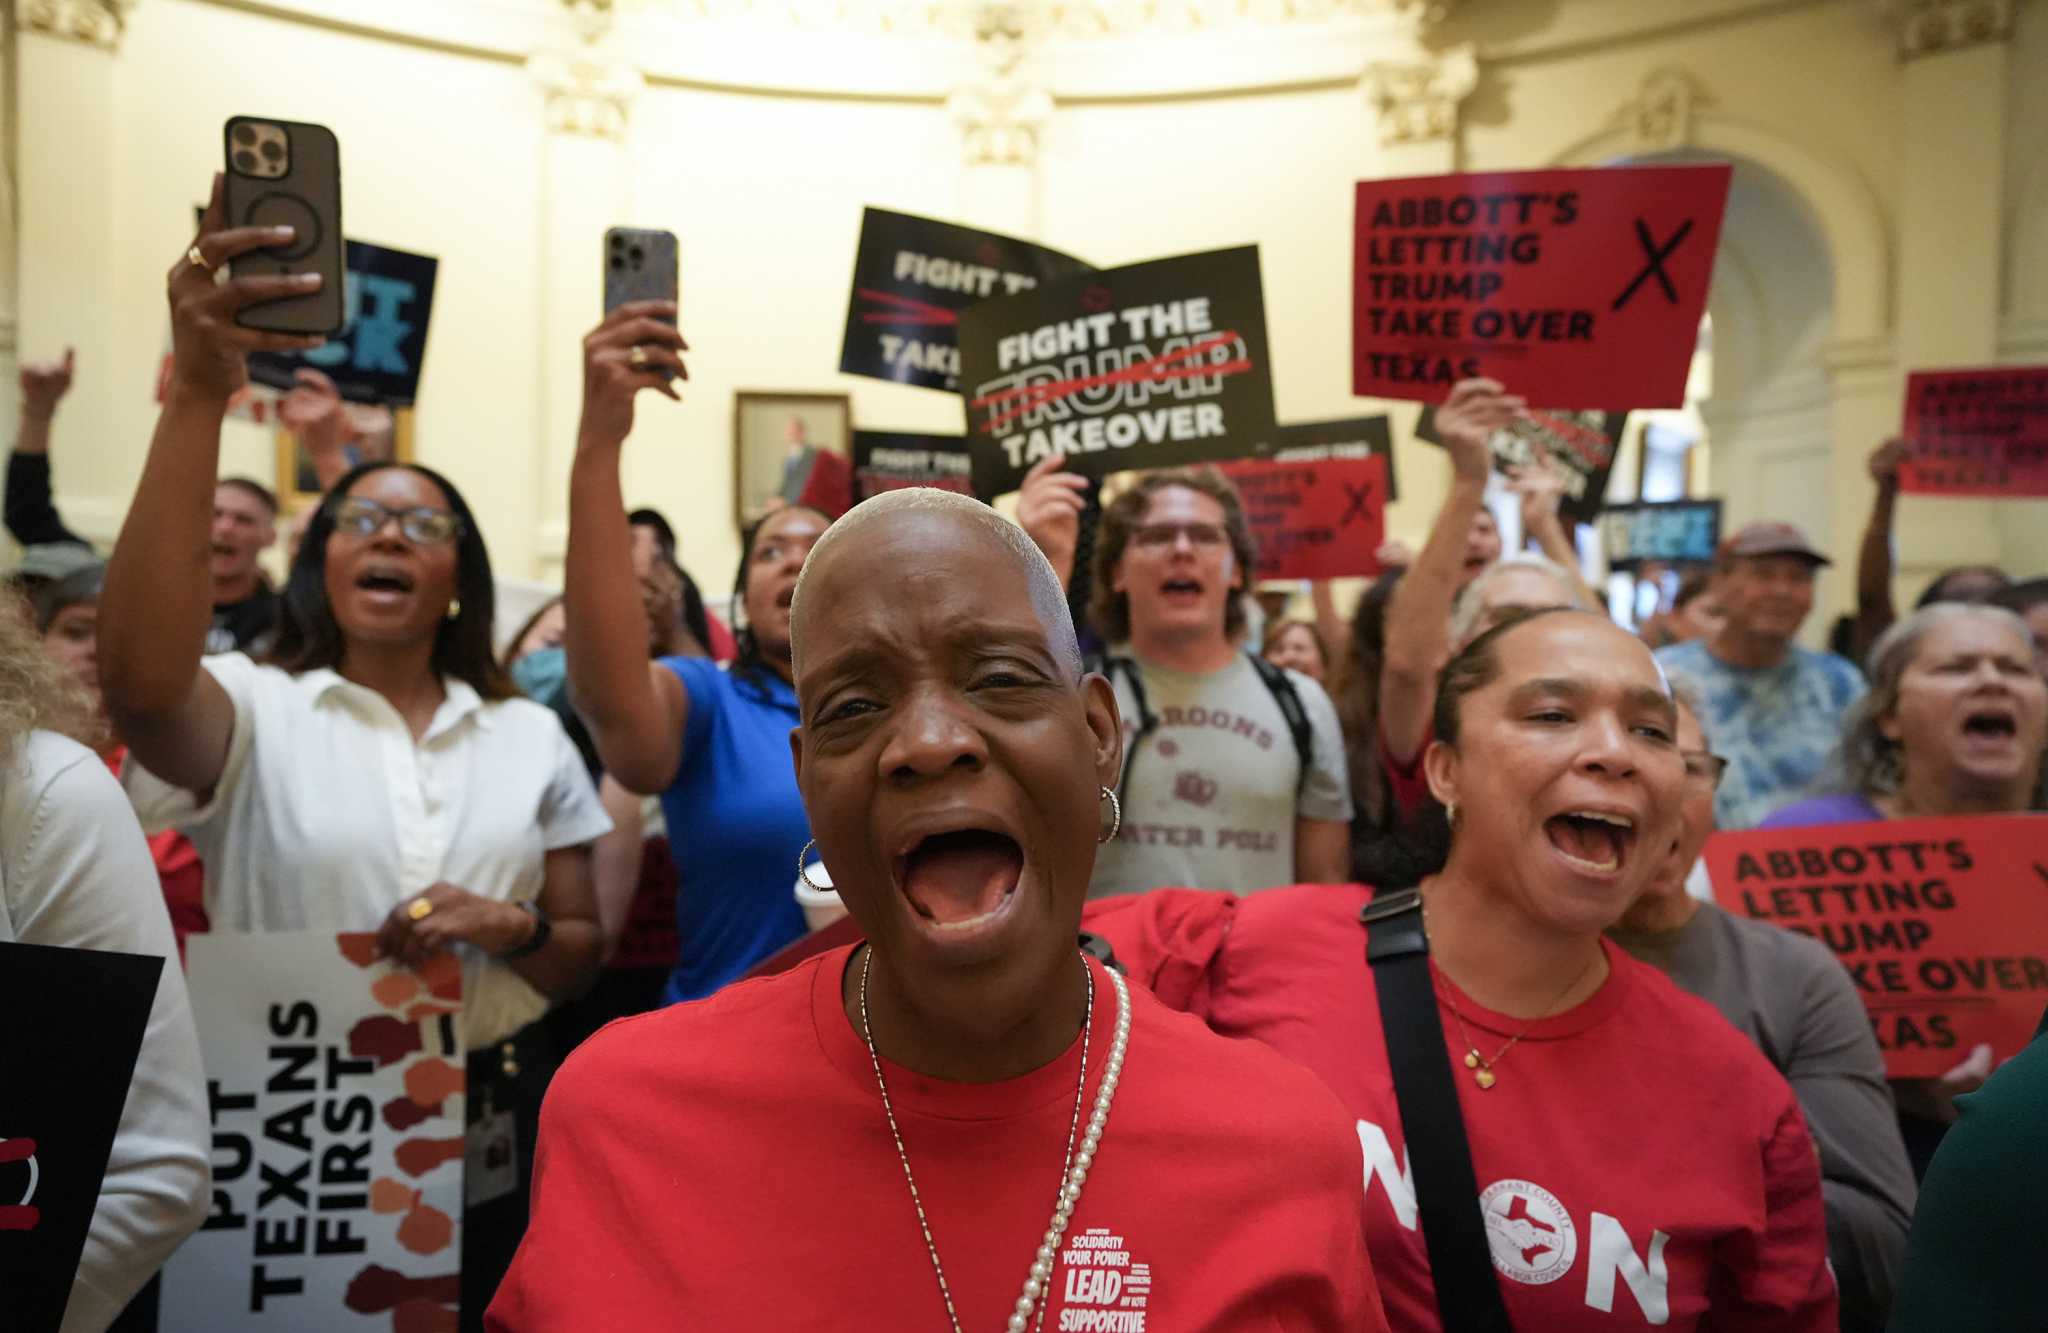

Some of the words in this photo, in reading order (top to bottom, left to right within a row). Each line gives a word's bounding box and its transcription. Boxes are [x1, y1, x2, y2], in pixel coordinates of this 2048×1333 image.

[1371, 190, 1579, 230] ABBOTT'S
[1368, 232, 1541, 266] LETTING
[893, 249, 999, 297] FIGHT
[1367, 271, 1504, 303] TRUMP
[997, 311, 1117, 371] FIGHT
[1121, 297, 1213, 342] THE
[1367, 307, 1462, 338] TAKE
[1471, 307, 1595, 341] OVER
[974, 330, 1248, 438] TRUMP
[1367, 352, 1480, 384] TEXAS
[999, 402, 1226, 468] TAKEOVER
[1162, 704, 1274, 751] ROONS
[1118, 823, 1204, 847] ATER
[1735, 839, 1974, 883] ABBOTT'S
[1741, 878, 1957, 920] LETTING
[1788, 919, 1933, 953] UMP
[1846, 959, 1910, 993] KE
[1918, 954, 2048, 992] OVER
[200, 1079, 257, 1231] PUT
[250, 1000, 319, 1314] TEXANS
[315, 1047, 377, 1257] FIRST
[1062, 1250, 1092, 1266] YOUR
[1092, 1250, 1130, 1267] POWER
[1071, 1235, 1124, 1250] SOLIDARITY
[1064, 1268, 1122, 1306] LEAD
[1058, 1308, 1147, 1333] SUPPORTIVE
